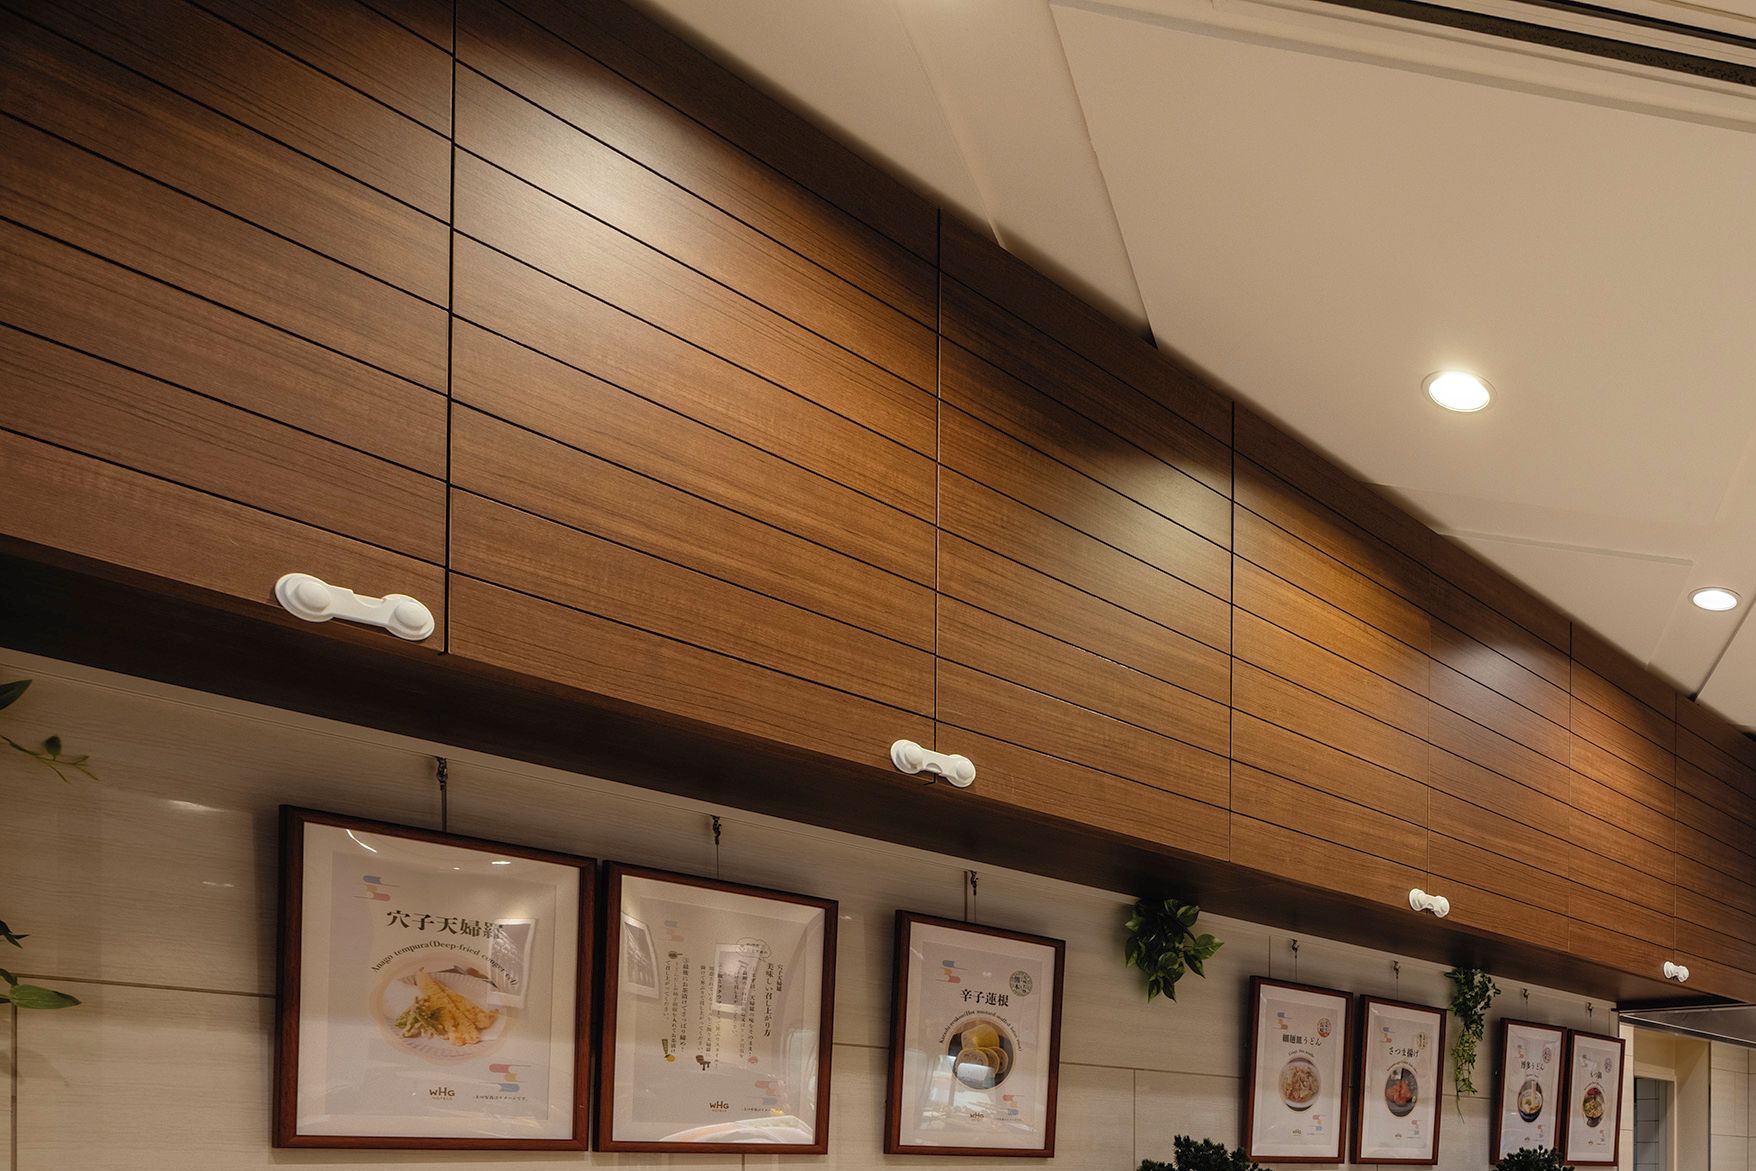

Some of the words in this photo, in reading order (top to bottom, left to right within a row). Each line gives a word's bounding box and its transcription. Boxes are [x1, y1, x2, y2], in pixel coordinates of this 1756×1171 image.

[386, 910, 504, 939] 穴子天婦羅
[371, 954, 394, 973] Anago
[961, 989, 1009, 1007] 辛子蓮根
[429, 1087, 455, 1096] WHG
